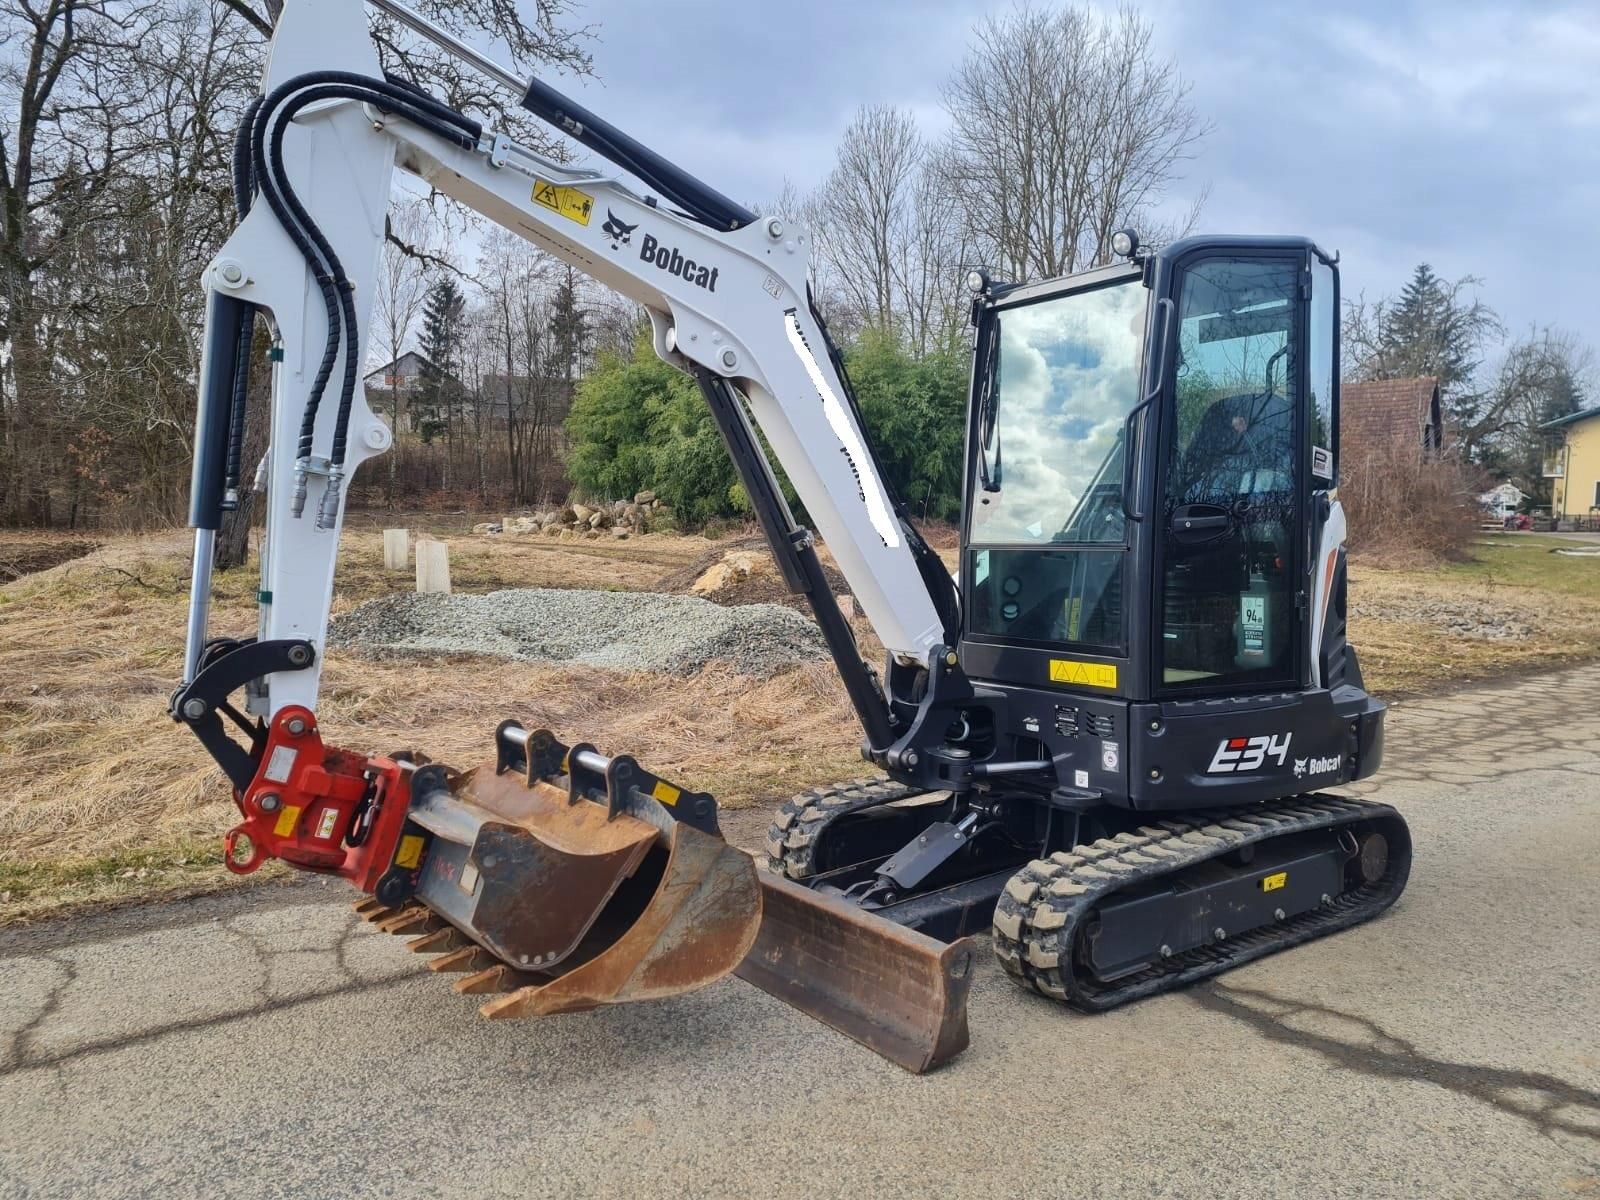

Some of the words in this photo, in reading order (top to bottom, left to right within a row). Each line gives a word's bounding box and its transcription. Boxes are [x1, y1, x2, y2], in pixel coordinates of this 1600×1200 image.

[640, 233, 719, 293] Bobcat
[1246, 609, 1257, 623] 94
[1207, 731, 1292, 773] E34
